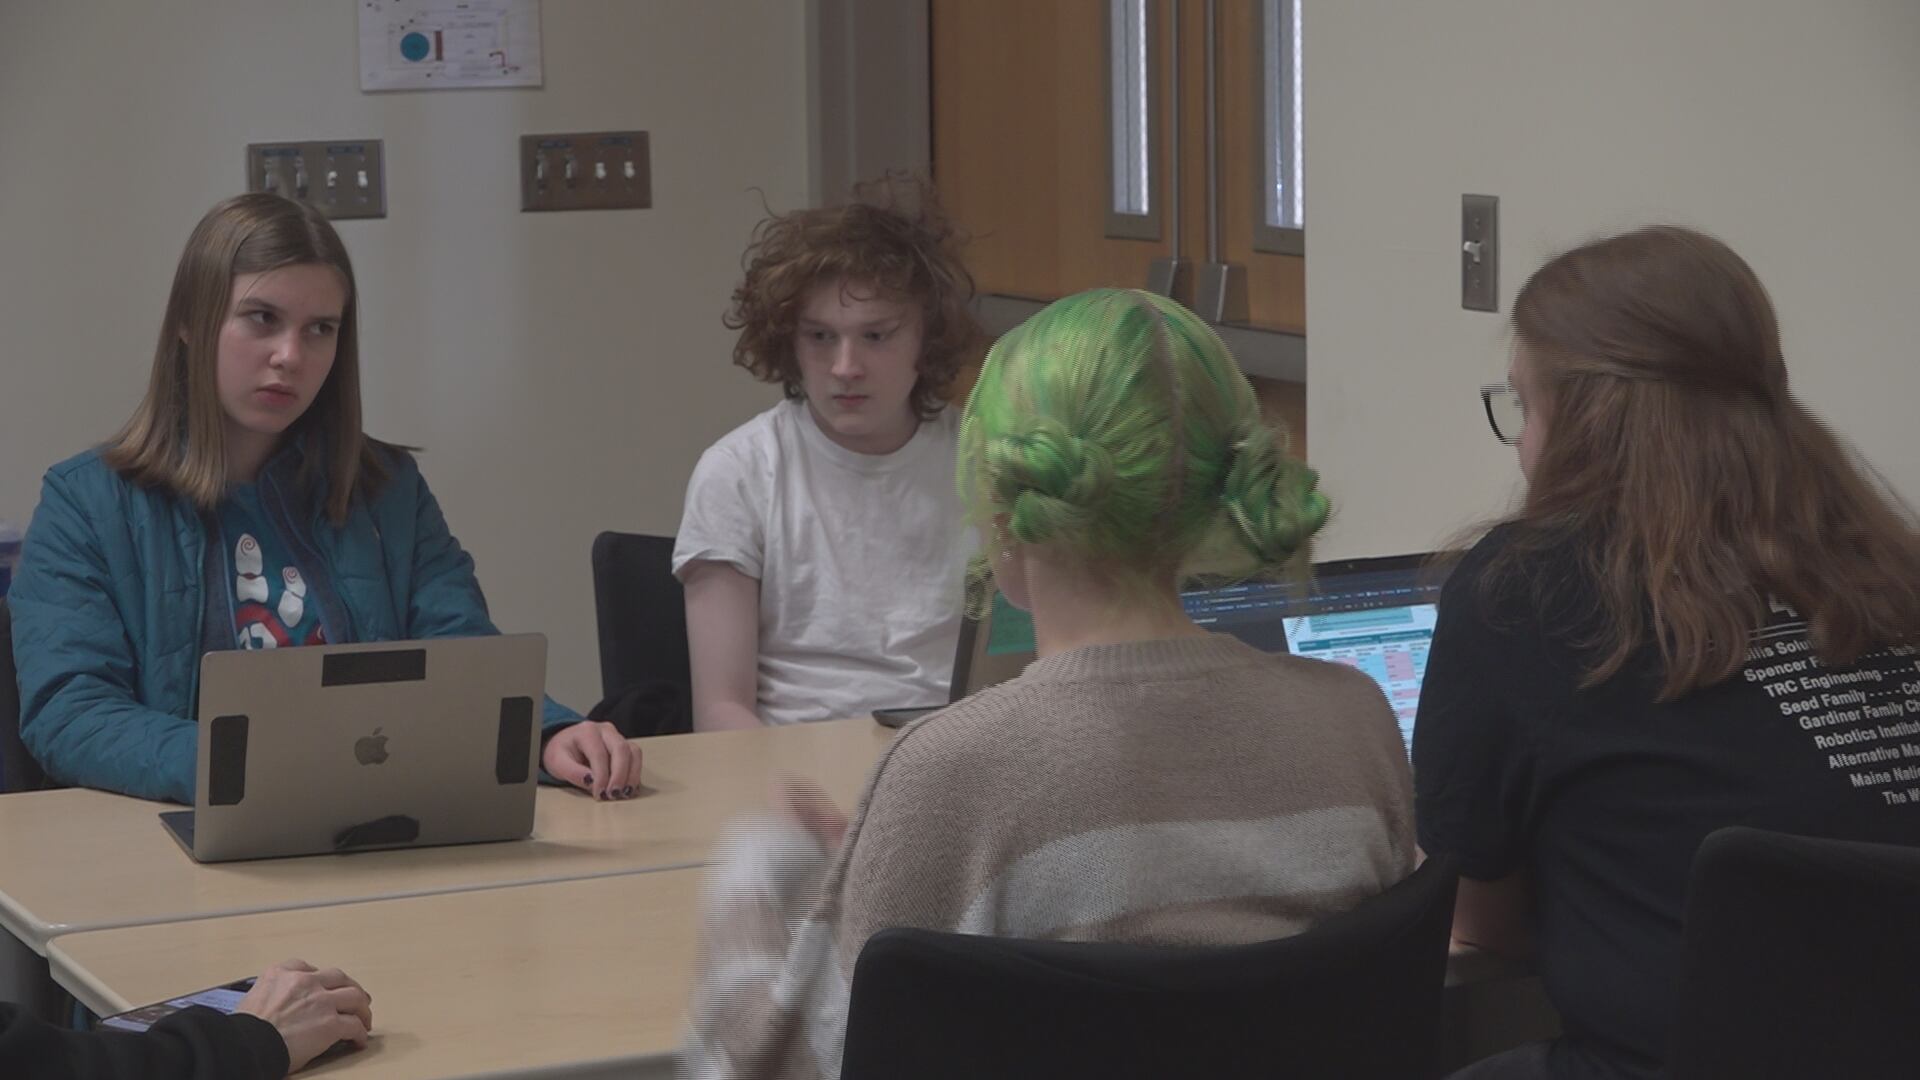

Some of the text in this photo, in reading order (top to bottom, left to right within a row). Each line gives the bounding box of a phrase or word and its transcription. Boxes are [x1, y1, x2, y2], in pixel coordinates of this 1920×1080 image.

[1744, 659, 1808, 682] Spencer
[1763, 668, 1882, 698] TRC Engineering
[1780, 695, 1820, 716] Seed
[1821, 689, 1867, 708] Family
[1799, 707, 1861, 730] Gardiner
[1862, 701, 1904, 720] Family
[1814, 725, 1878, 750] Robotics
[1828, 745, 1901, 769] Alternative
[1850, 769, 1892, 787] Maine
[1882, 790, 1907, 805] The
